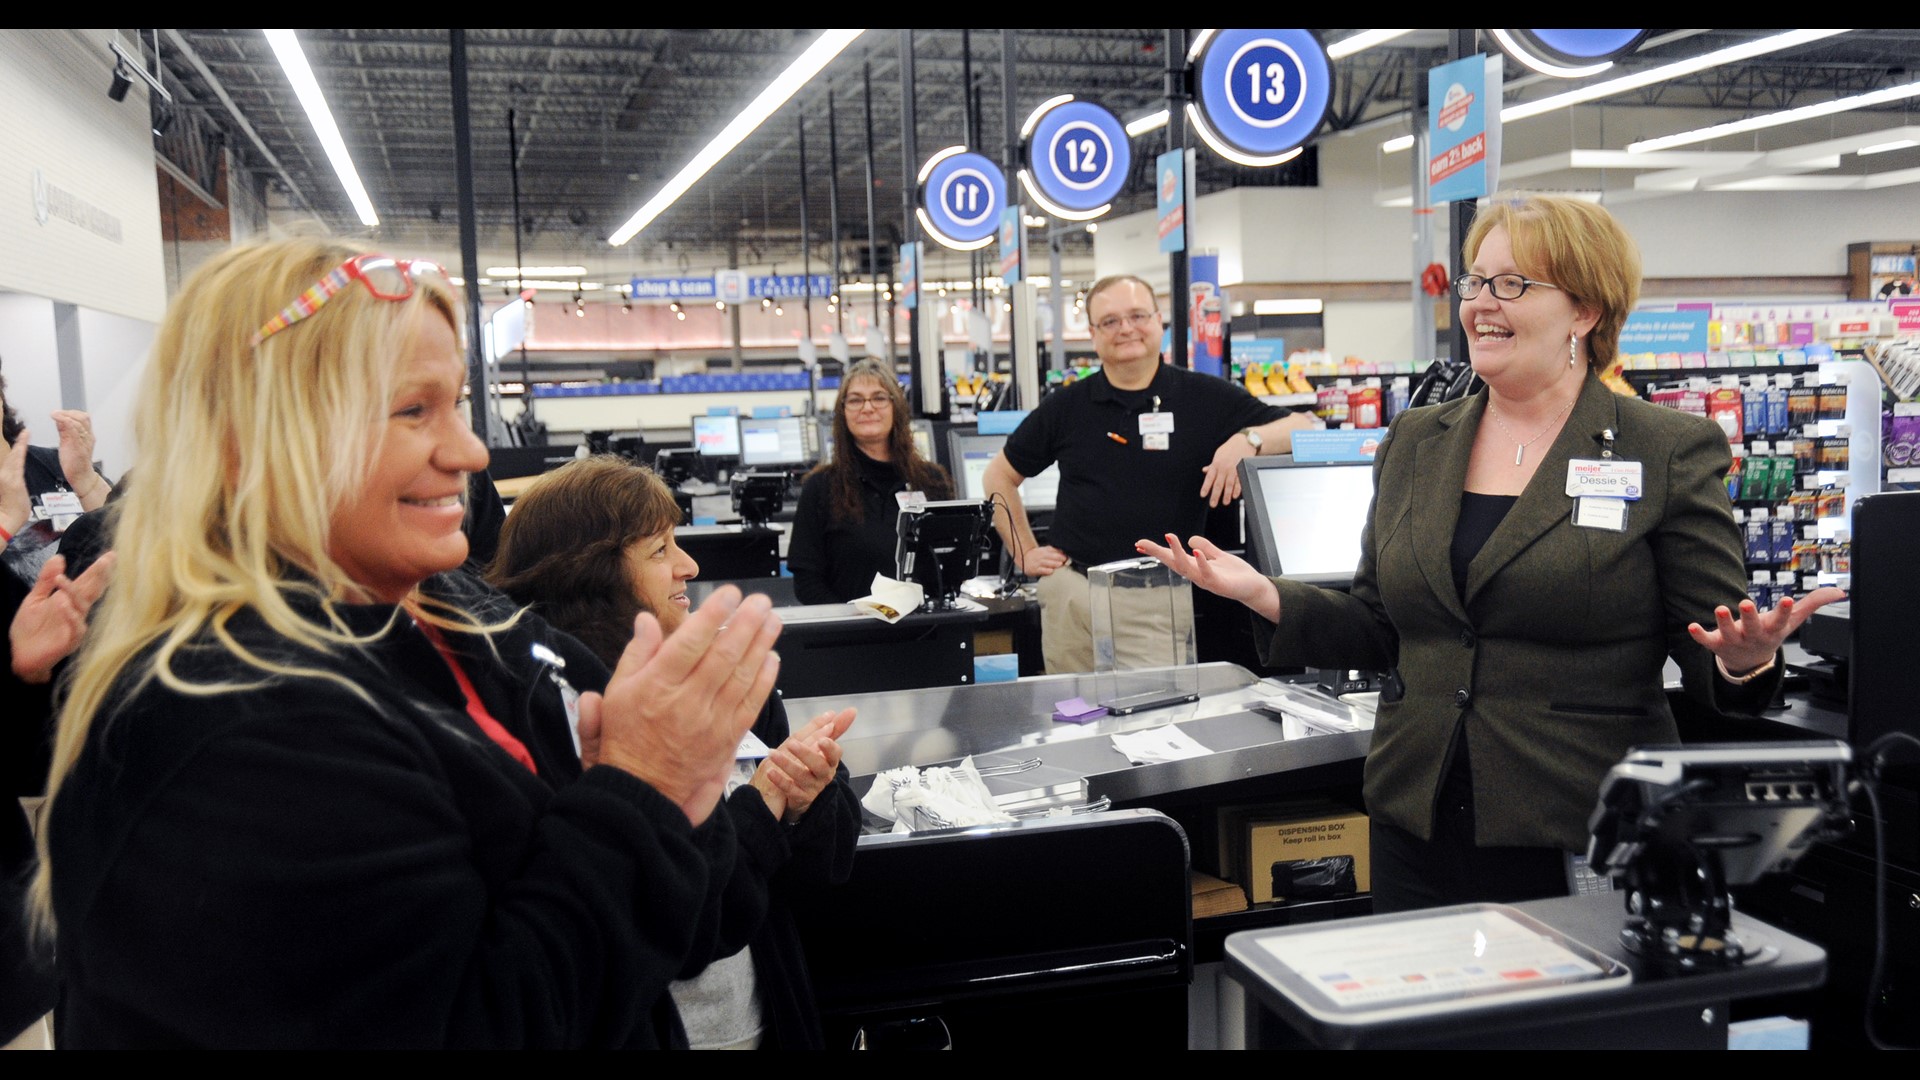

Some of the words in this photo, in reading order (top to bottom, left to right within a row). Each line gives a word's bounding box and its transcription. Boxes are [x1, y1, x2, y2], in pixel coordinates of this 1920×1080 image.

[1247, 62, 1286, 104] 13
[1066, 139, 1097, 172] 12
[1431, 154, 1449, 176] earn
[1461, 135, 1483, 160] back
[637, 278, 667, 297] shop
[669, 278, 681, 295] &
[681, 280, 712, 295] scan
[1790, 388, 1814, 396] DURACELL
[1821, 387, 1846, 396] DURACELL
[1823, 439, 1848, 447] DURACELL
[1575, 465, 1602, 473] meijer
[1580, 475, 1617, 485] Dessie
[1278, 824, 1327, 836] DISPENSING
[1328, 823, 1346, 832] BOX
[1283, 836, 1303, 845] Keep
